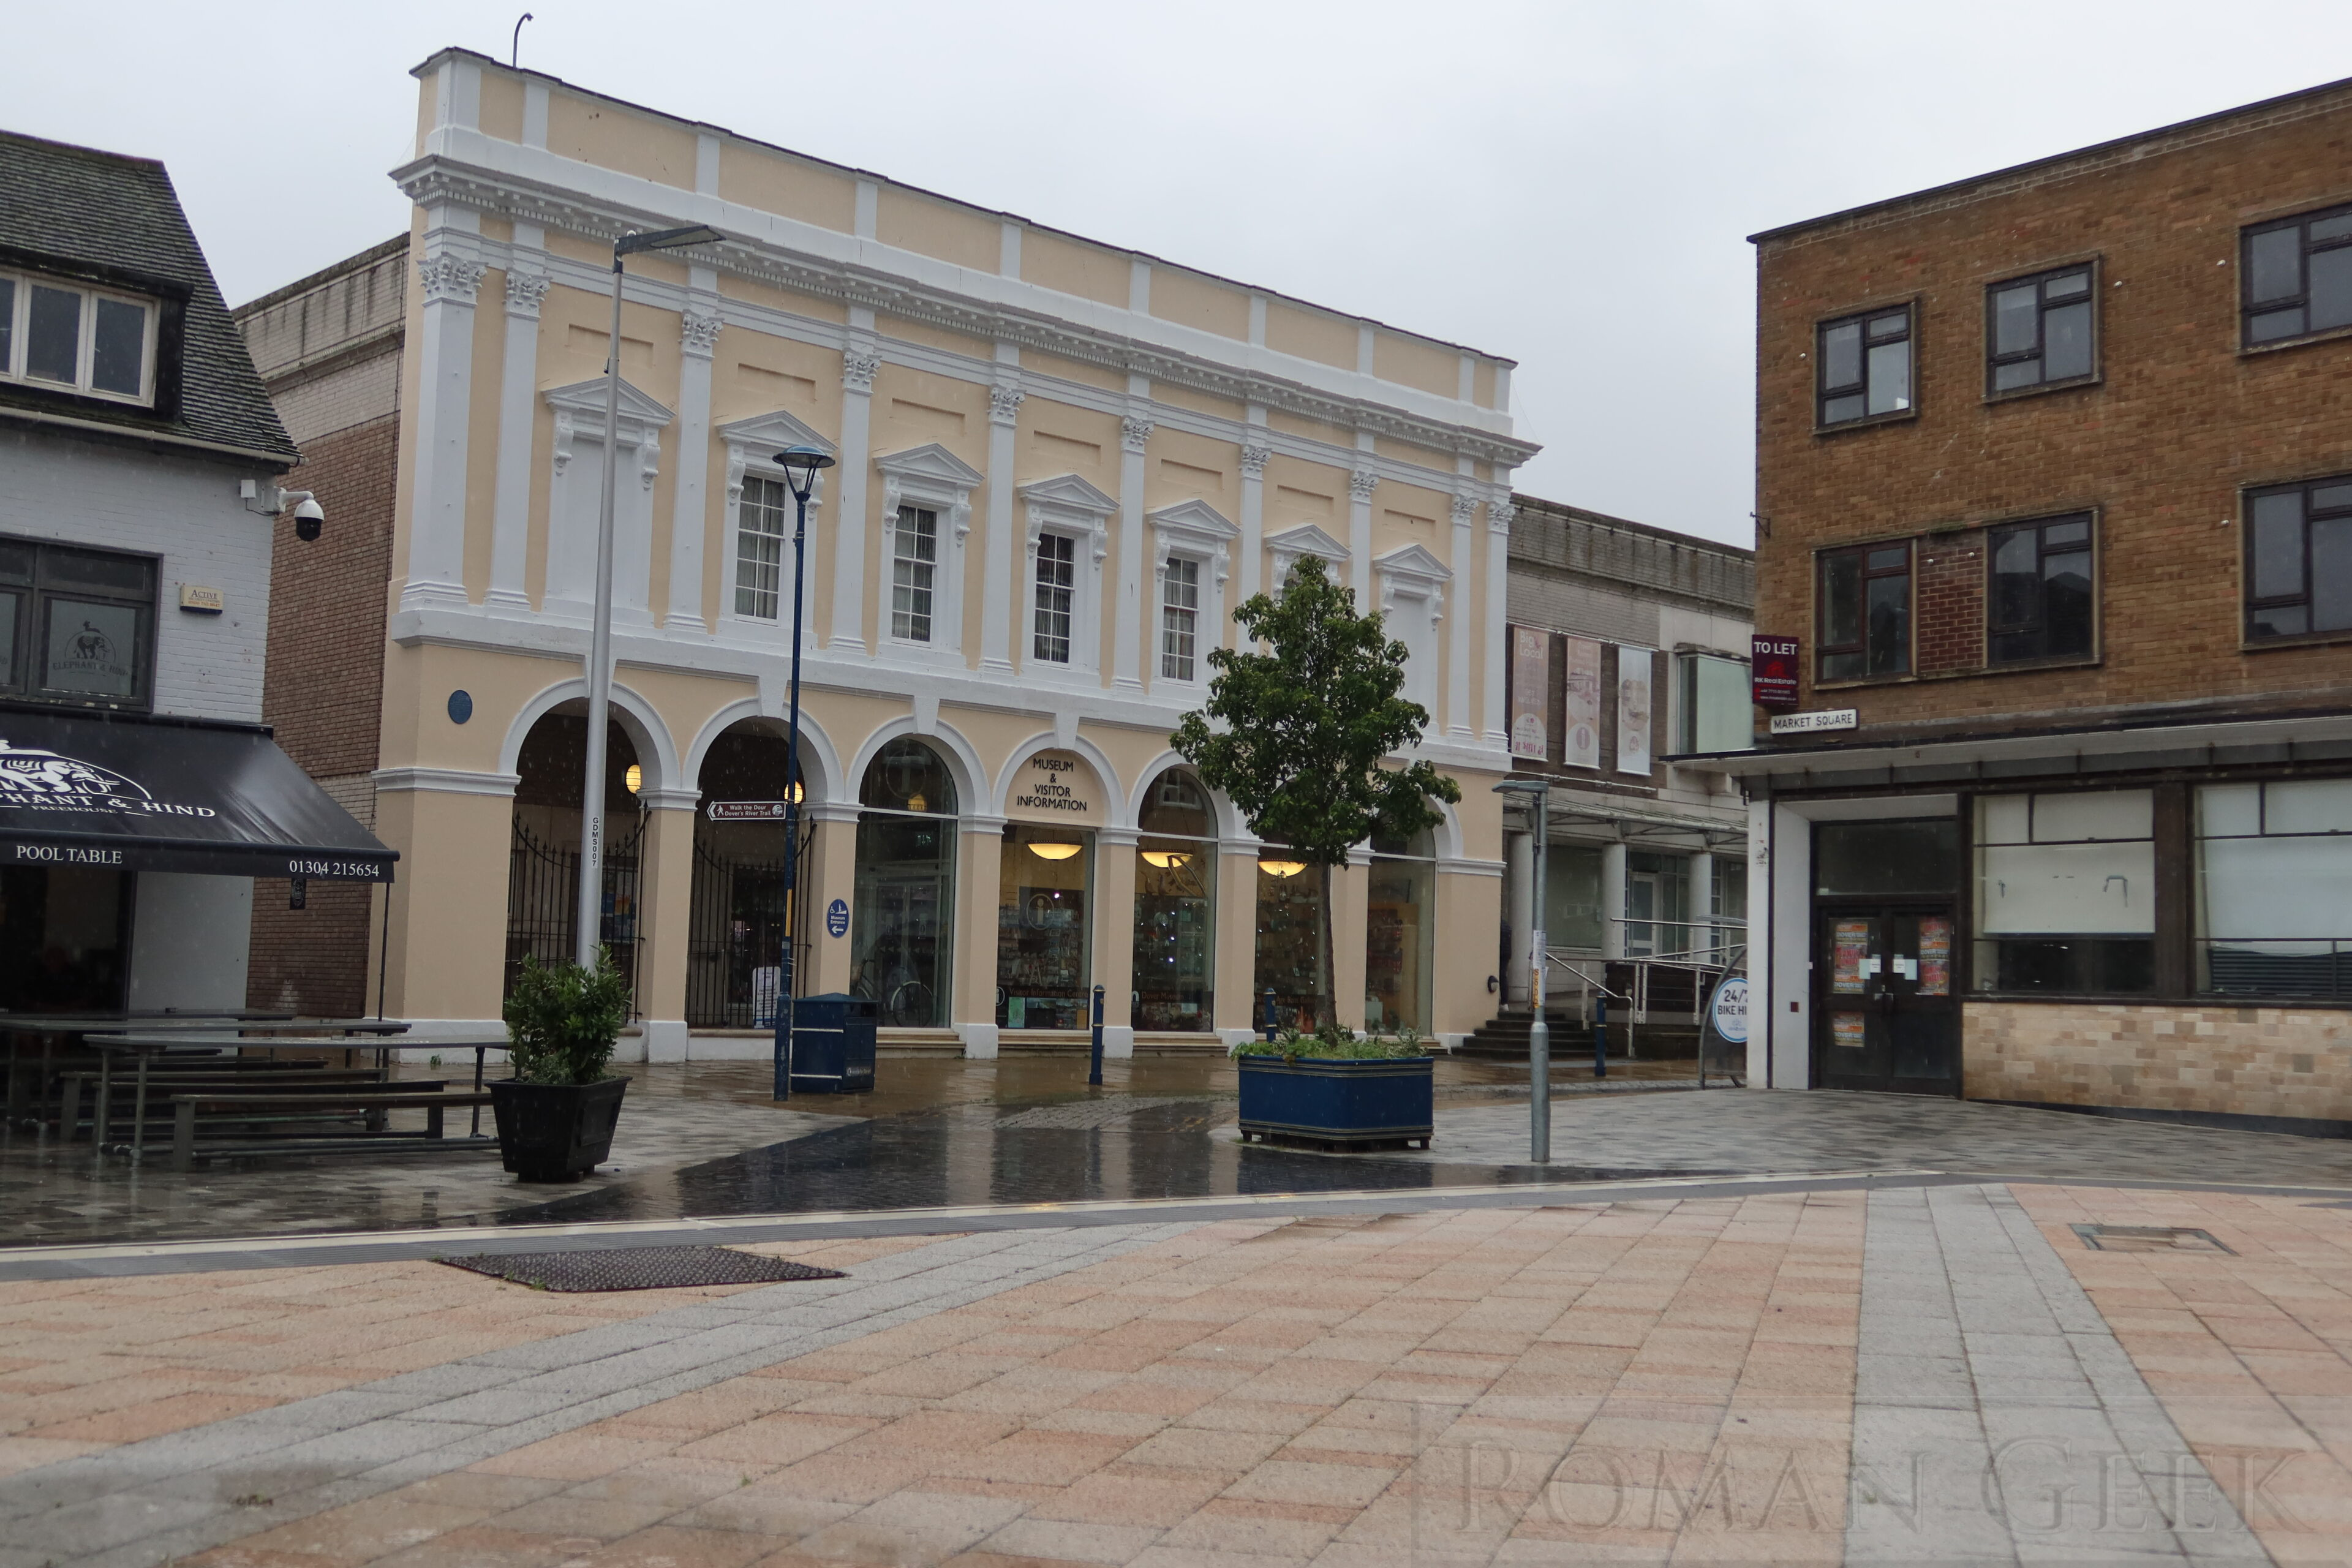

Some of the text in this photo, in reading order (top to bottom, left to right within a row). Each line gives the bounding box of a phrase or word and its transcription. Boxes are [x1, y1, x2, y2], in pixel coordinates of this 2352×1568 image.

[1519, 631, 1535, 647] Big
[1519, 645, 1544, 659] Local
[1754, 642, 1797, 655] TO LET
[1774, 714, 1852, 729] MARKET SQUARE
[1033, 758, 1073, 772] MUSEUM
[1050, 773, 1057, 783] &
[1035, 784, 1071, 797] VISITOR
[0, 793, 216, 818] HANT & HIND
[1017, 795, 1087, 811] INFORMATION
[17, 845, 123, 864] POOL TABLE
[289, 860, 379, 877] 01304 215654
[1009, 988, 1029, 997] Visitor
[1031, 989, 1066, 998] Information
[1718, 1005, 1747, 1016] BIKE HI
